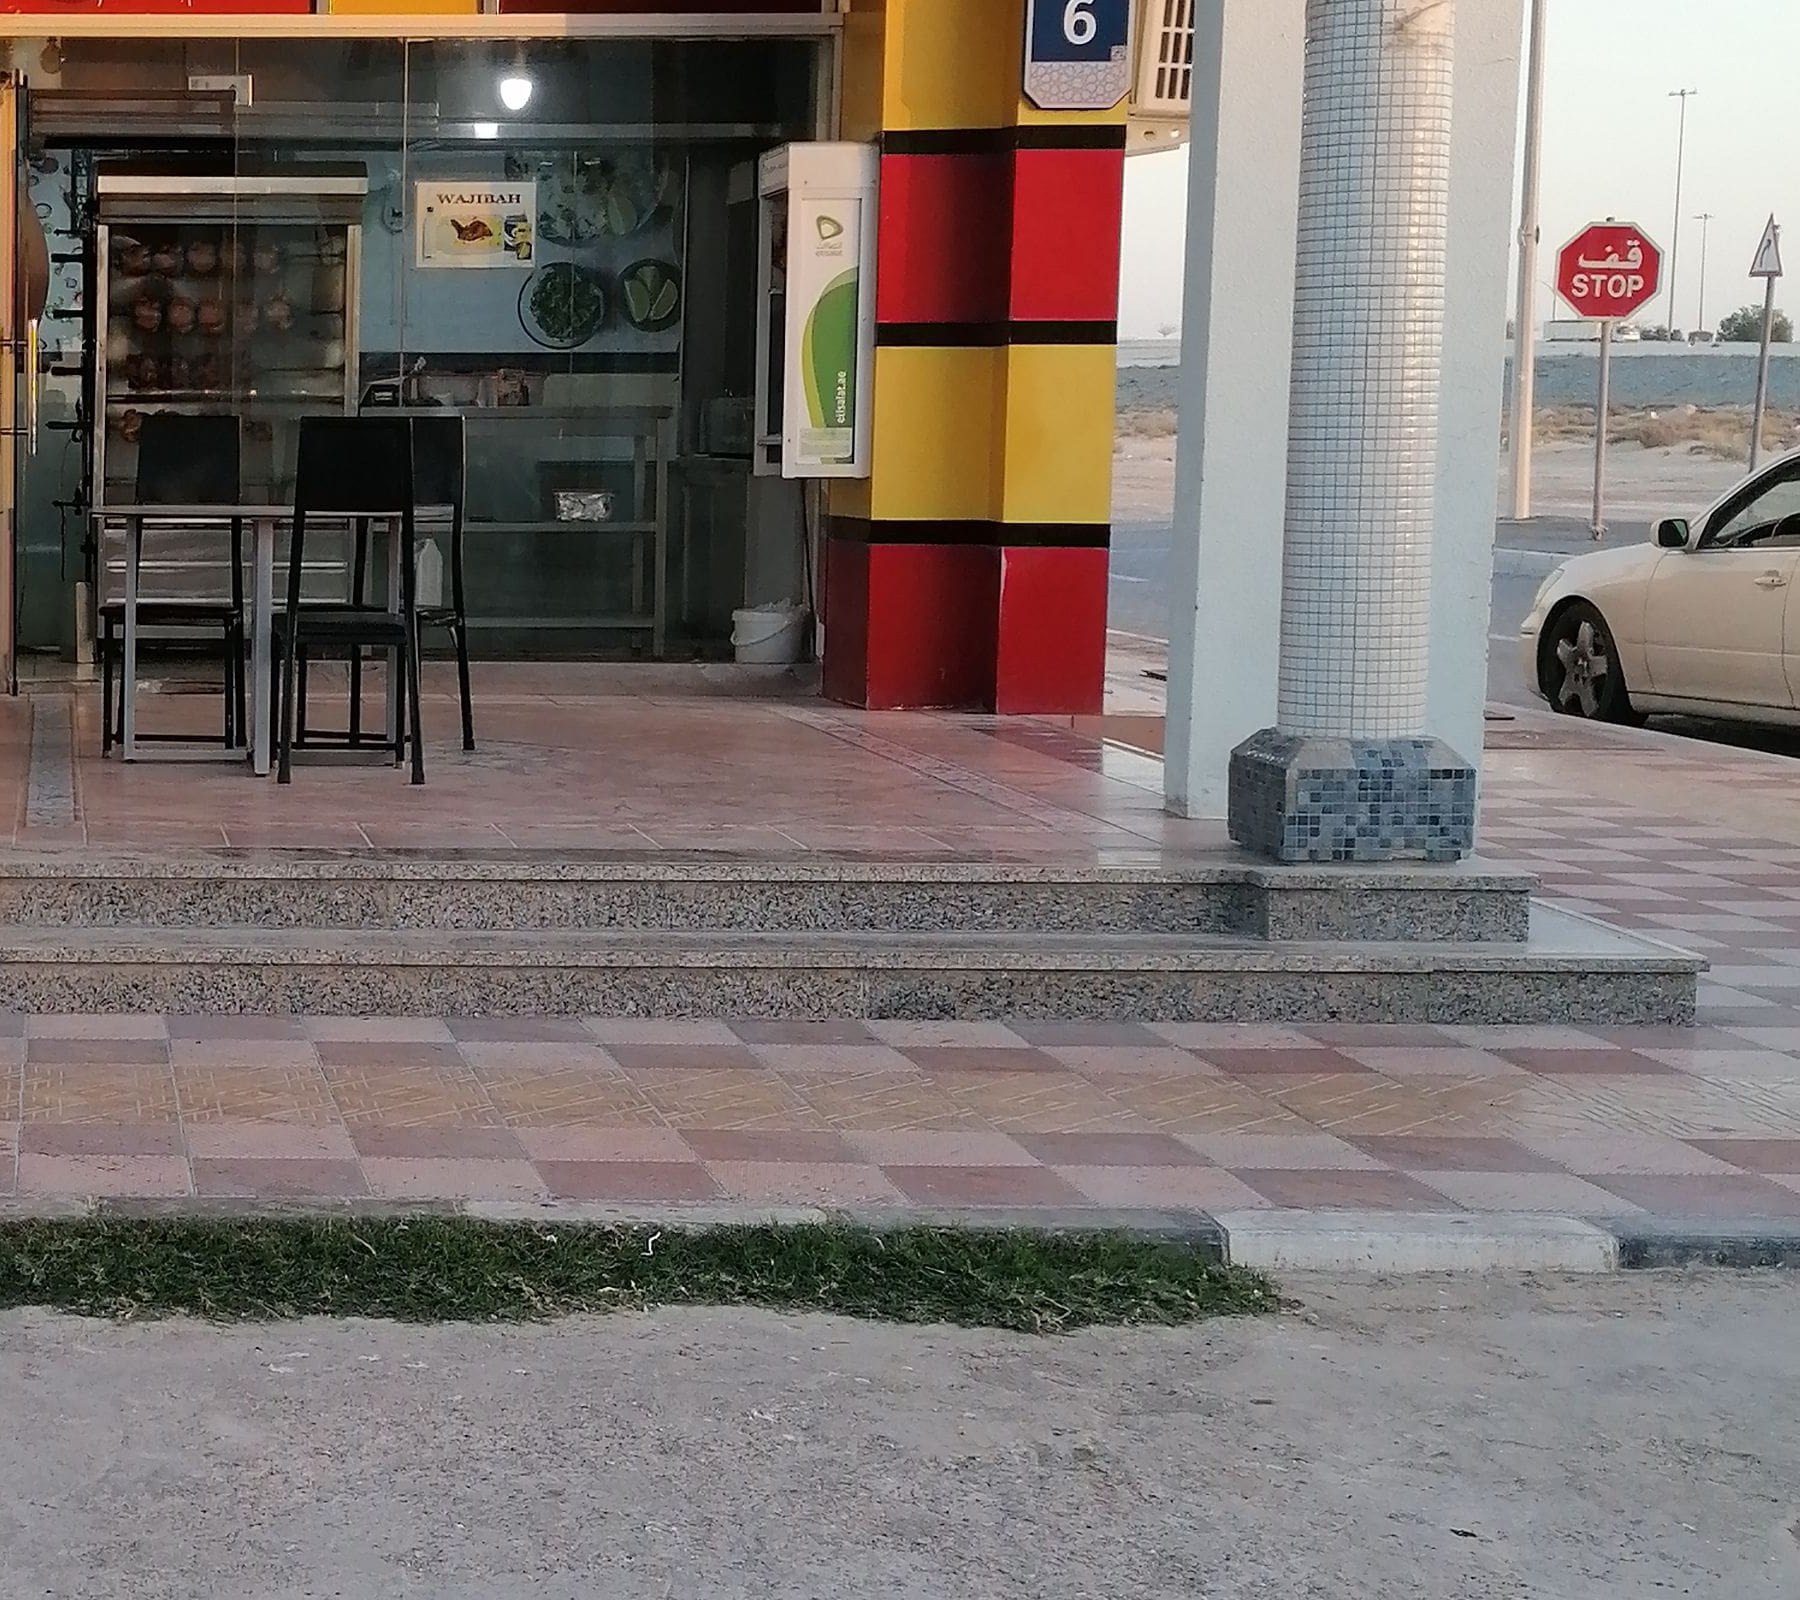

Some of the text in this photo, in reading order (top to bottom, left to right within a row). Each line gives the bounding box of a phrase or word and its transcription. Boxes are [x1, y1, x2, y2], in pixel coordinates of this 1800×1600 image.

[436, 193, 521, 205] WAJIBAH
[1577, 239, 1644, 270] قف
[1571, 273, 1645, 298] STOP
[835, 371, 847, 423] etisalat.ae
